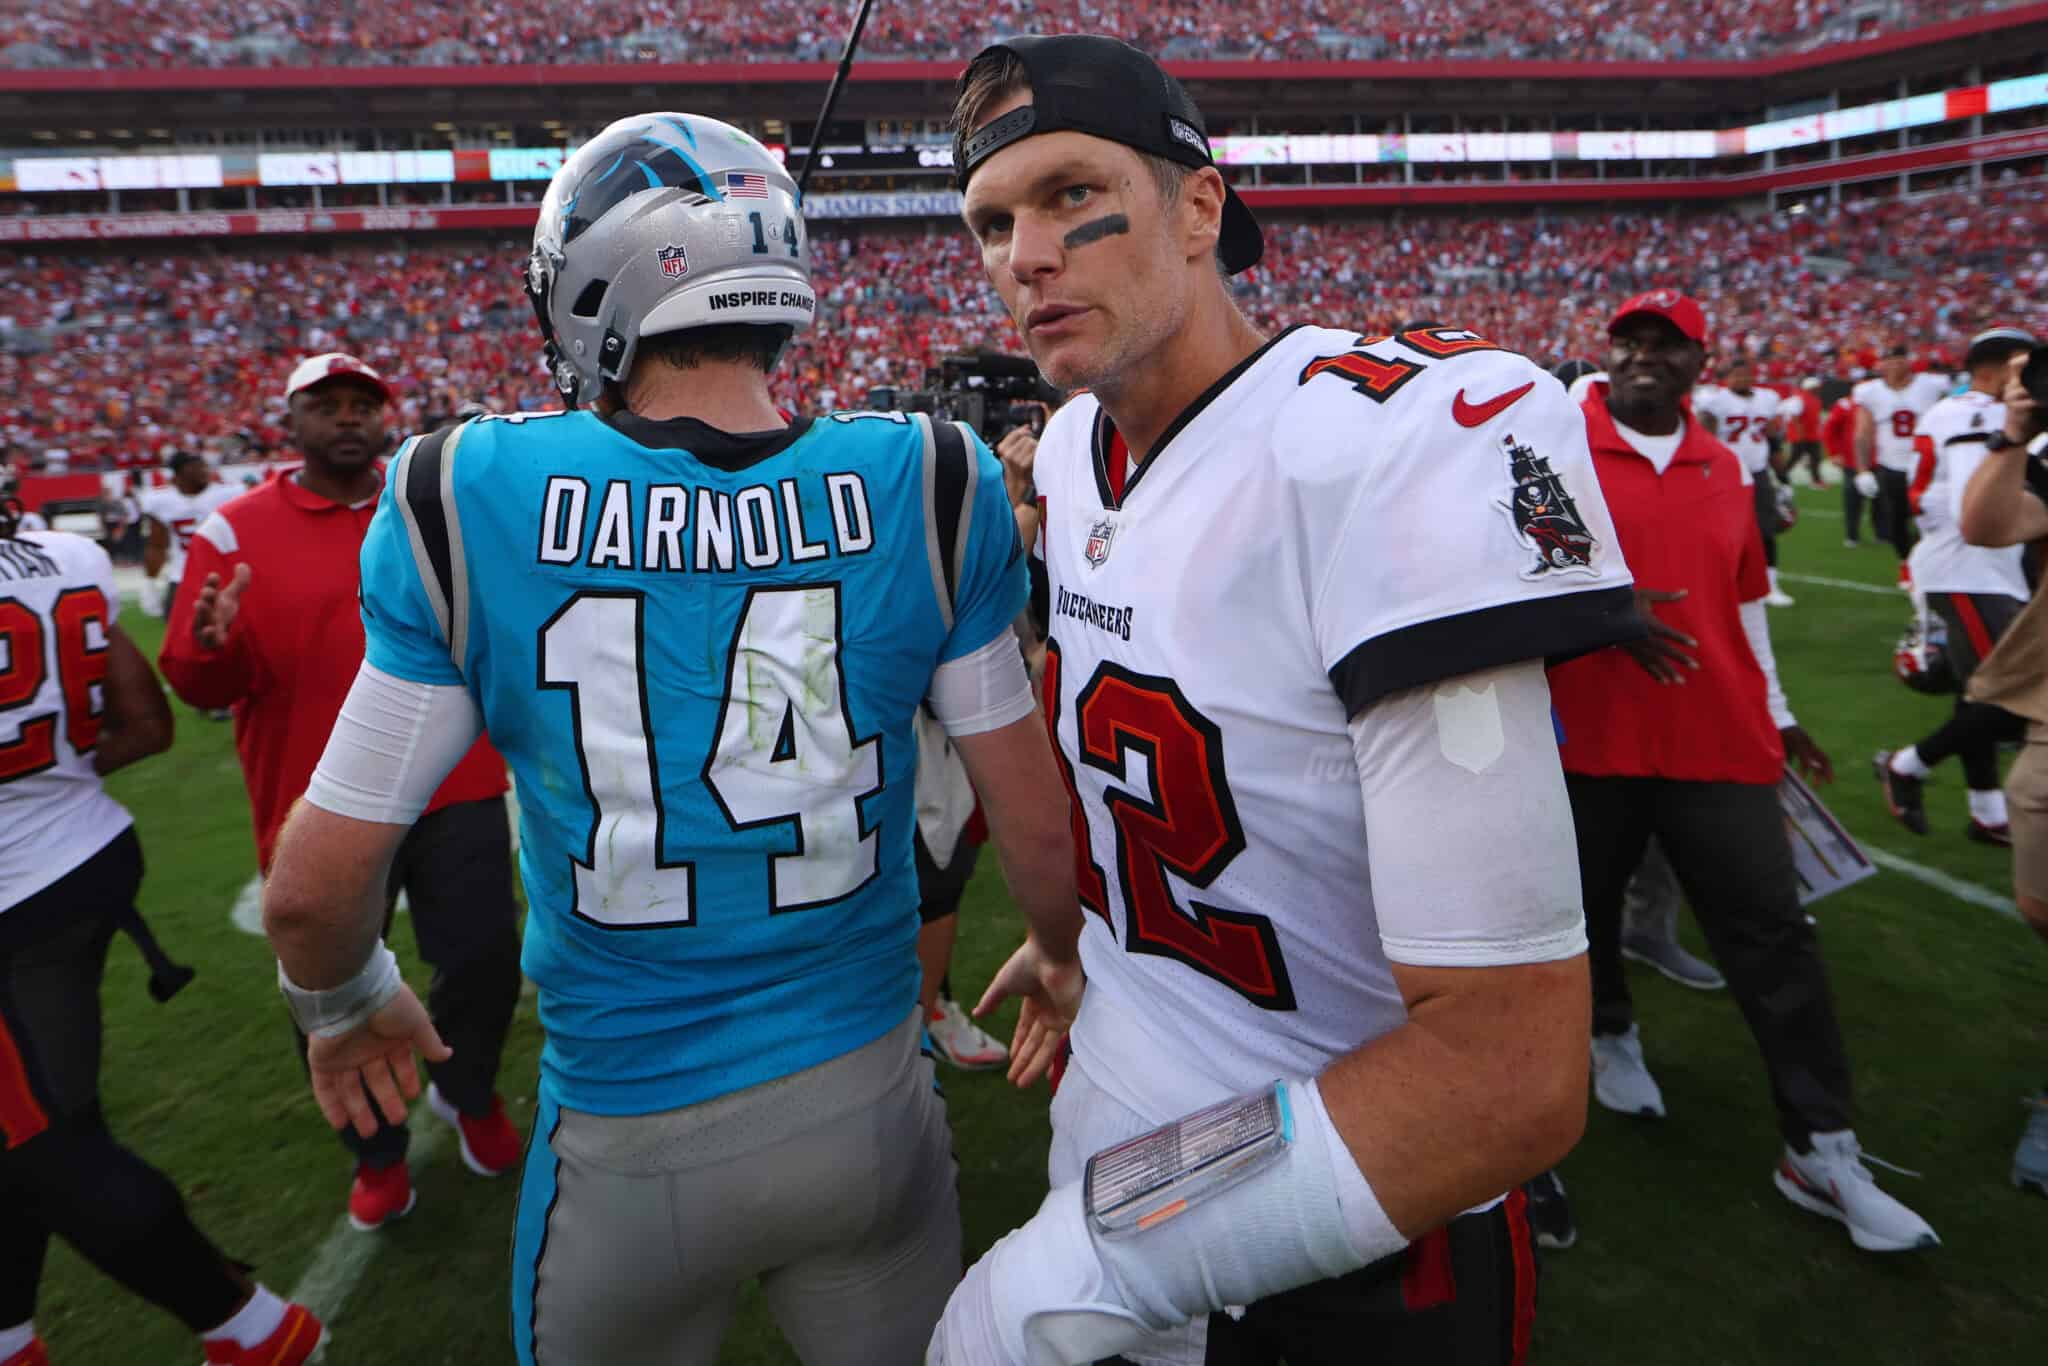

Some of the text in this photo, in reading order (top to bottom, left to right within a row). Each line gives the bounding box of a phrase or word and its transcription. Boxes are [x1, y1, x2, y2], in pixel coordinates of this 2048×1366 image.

[663, 258, 686, 275] NFL
[709, 291, 777, 311] INSPIRE
[1725, 415, 1769, 443] 73
[537, 470, 875, 573] DARNOLD
[1056, 584, 1134, 642] BUCCANEERS
[536, 580, 886, 931] 14
